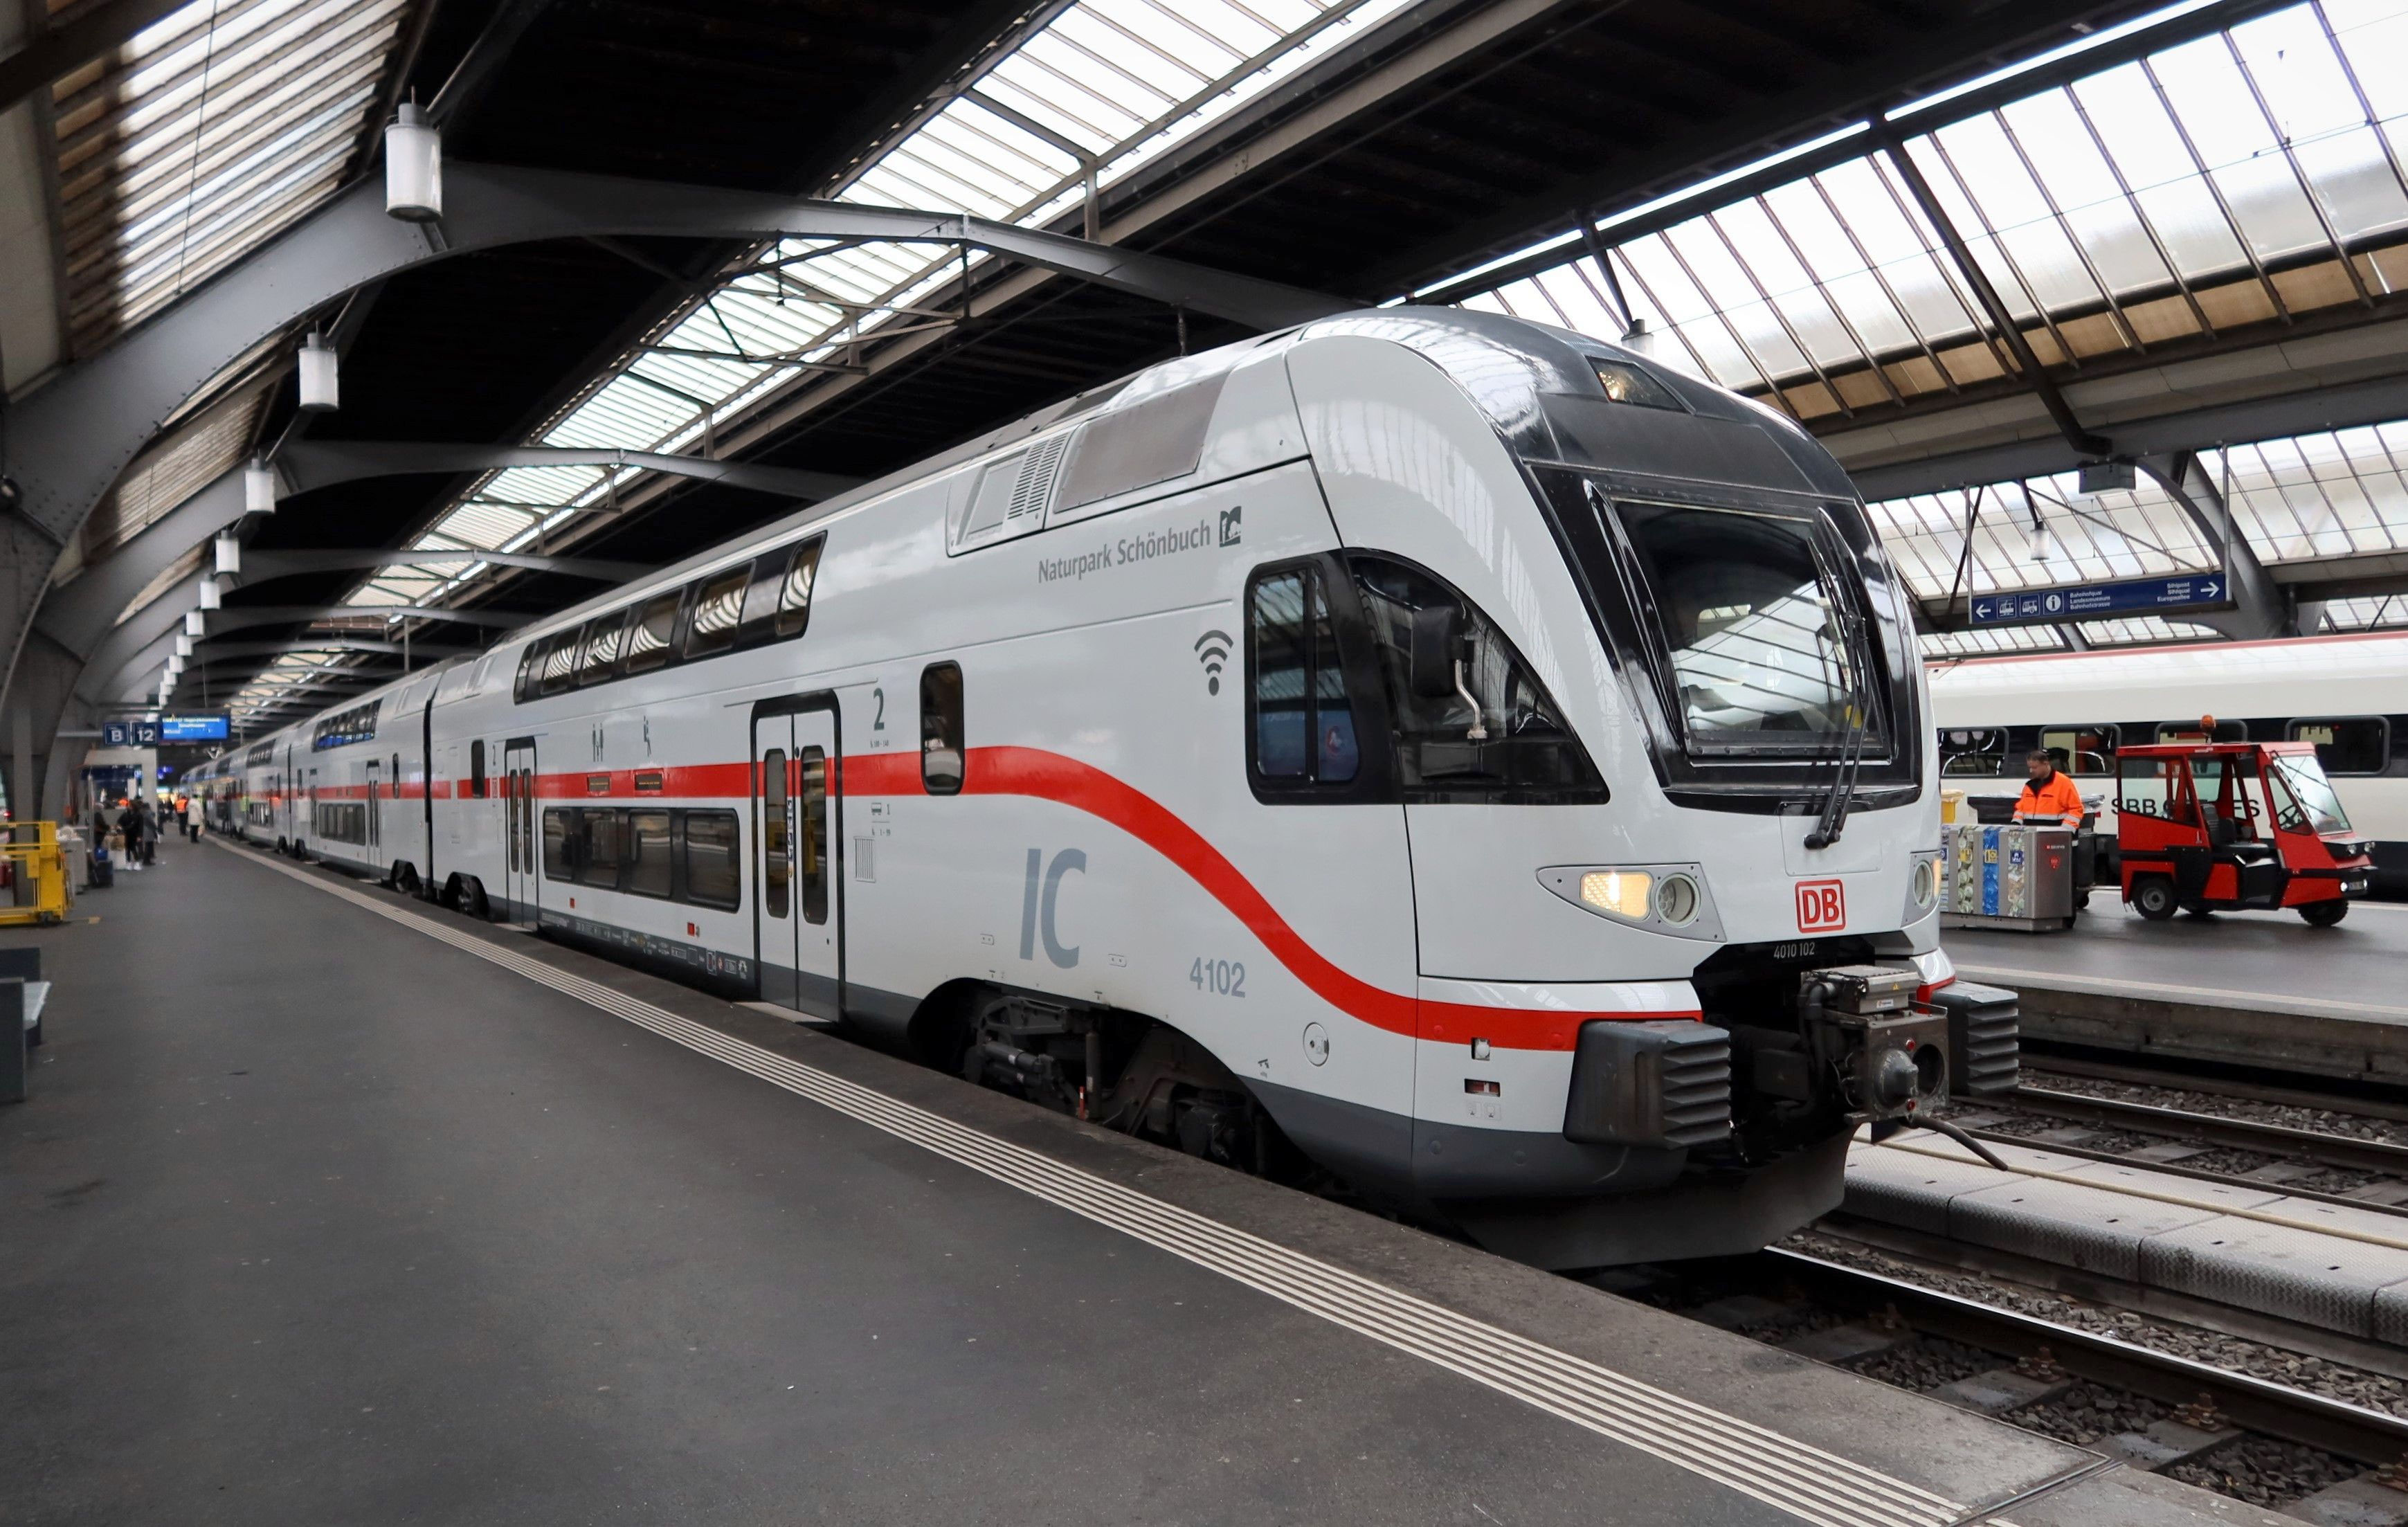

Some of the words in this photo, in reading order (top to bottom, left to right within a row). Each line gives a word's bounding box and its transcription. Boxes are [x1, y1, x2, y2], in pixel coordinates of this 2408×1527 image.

[1038, 544, 1112, 583] Naturpark
[1117, 520, 1211, 565] Schönbuch
[2070, 595, 2111, 604] Landesmuseum
[873, 688, 885, 731] 2
[111, 730, 123, 742] B
[137, 730, 155, 742] 12
[2111, 798, 2157, 817] SBB
[1020, 849, 1087, 969] IC
[1802, 888, 1840, 924] DB
[1773, 943, 1797, 959] 4010
[1800, 942, 1816, 957] 102
[1189, 957, 1246, 998] 4102
